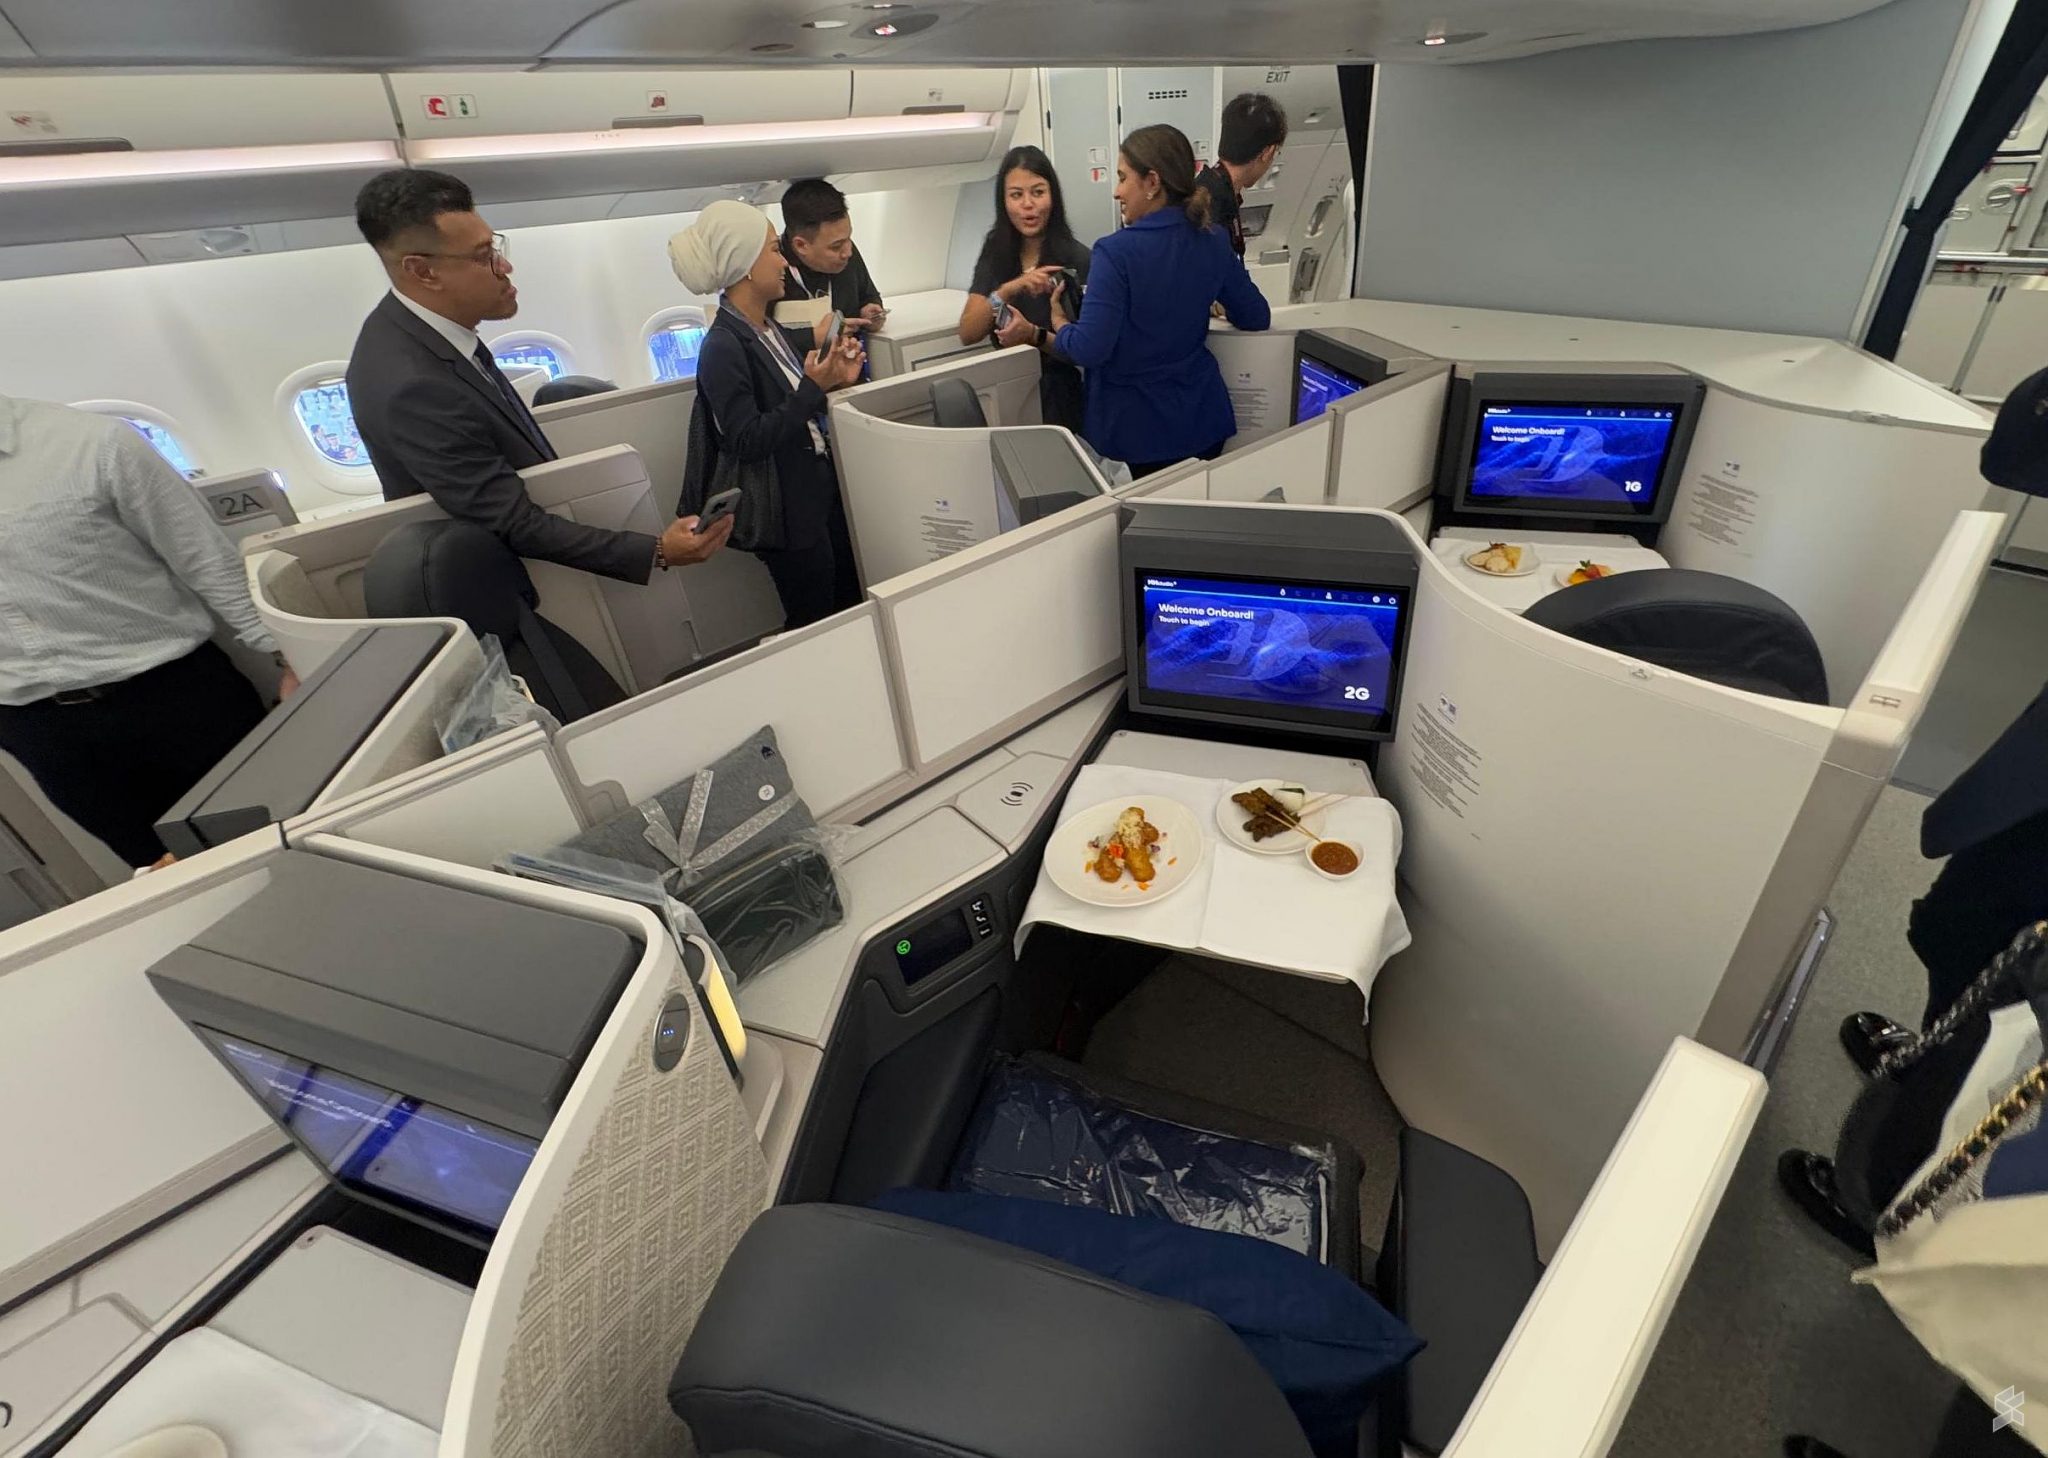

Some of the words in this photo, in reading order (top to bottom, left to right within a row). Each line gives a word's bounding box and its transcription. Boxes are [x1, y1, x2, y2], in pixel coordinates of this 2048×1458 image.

[1266, 71, 1291, 83] EXIT
[1492, 426, 1528, 434] Welcome
[1625, 480, 1642, 492] 1G
[219, 493, 264, 517] 2A
[1158, 603, 1205, 615] Welcome
[1206, 607, 1255, 620] Onboard!
[1158, 615, 1180, 624] Touch
[1189, 618, 1210, 628] begin
[1344, 685, 1370, 701] 2G
